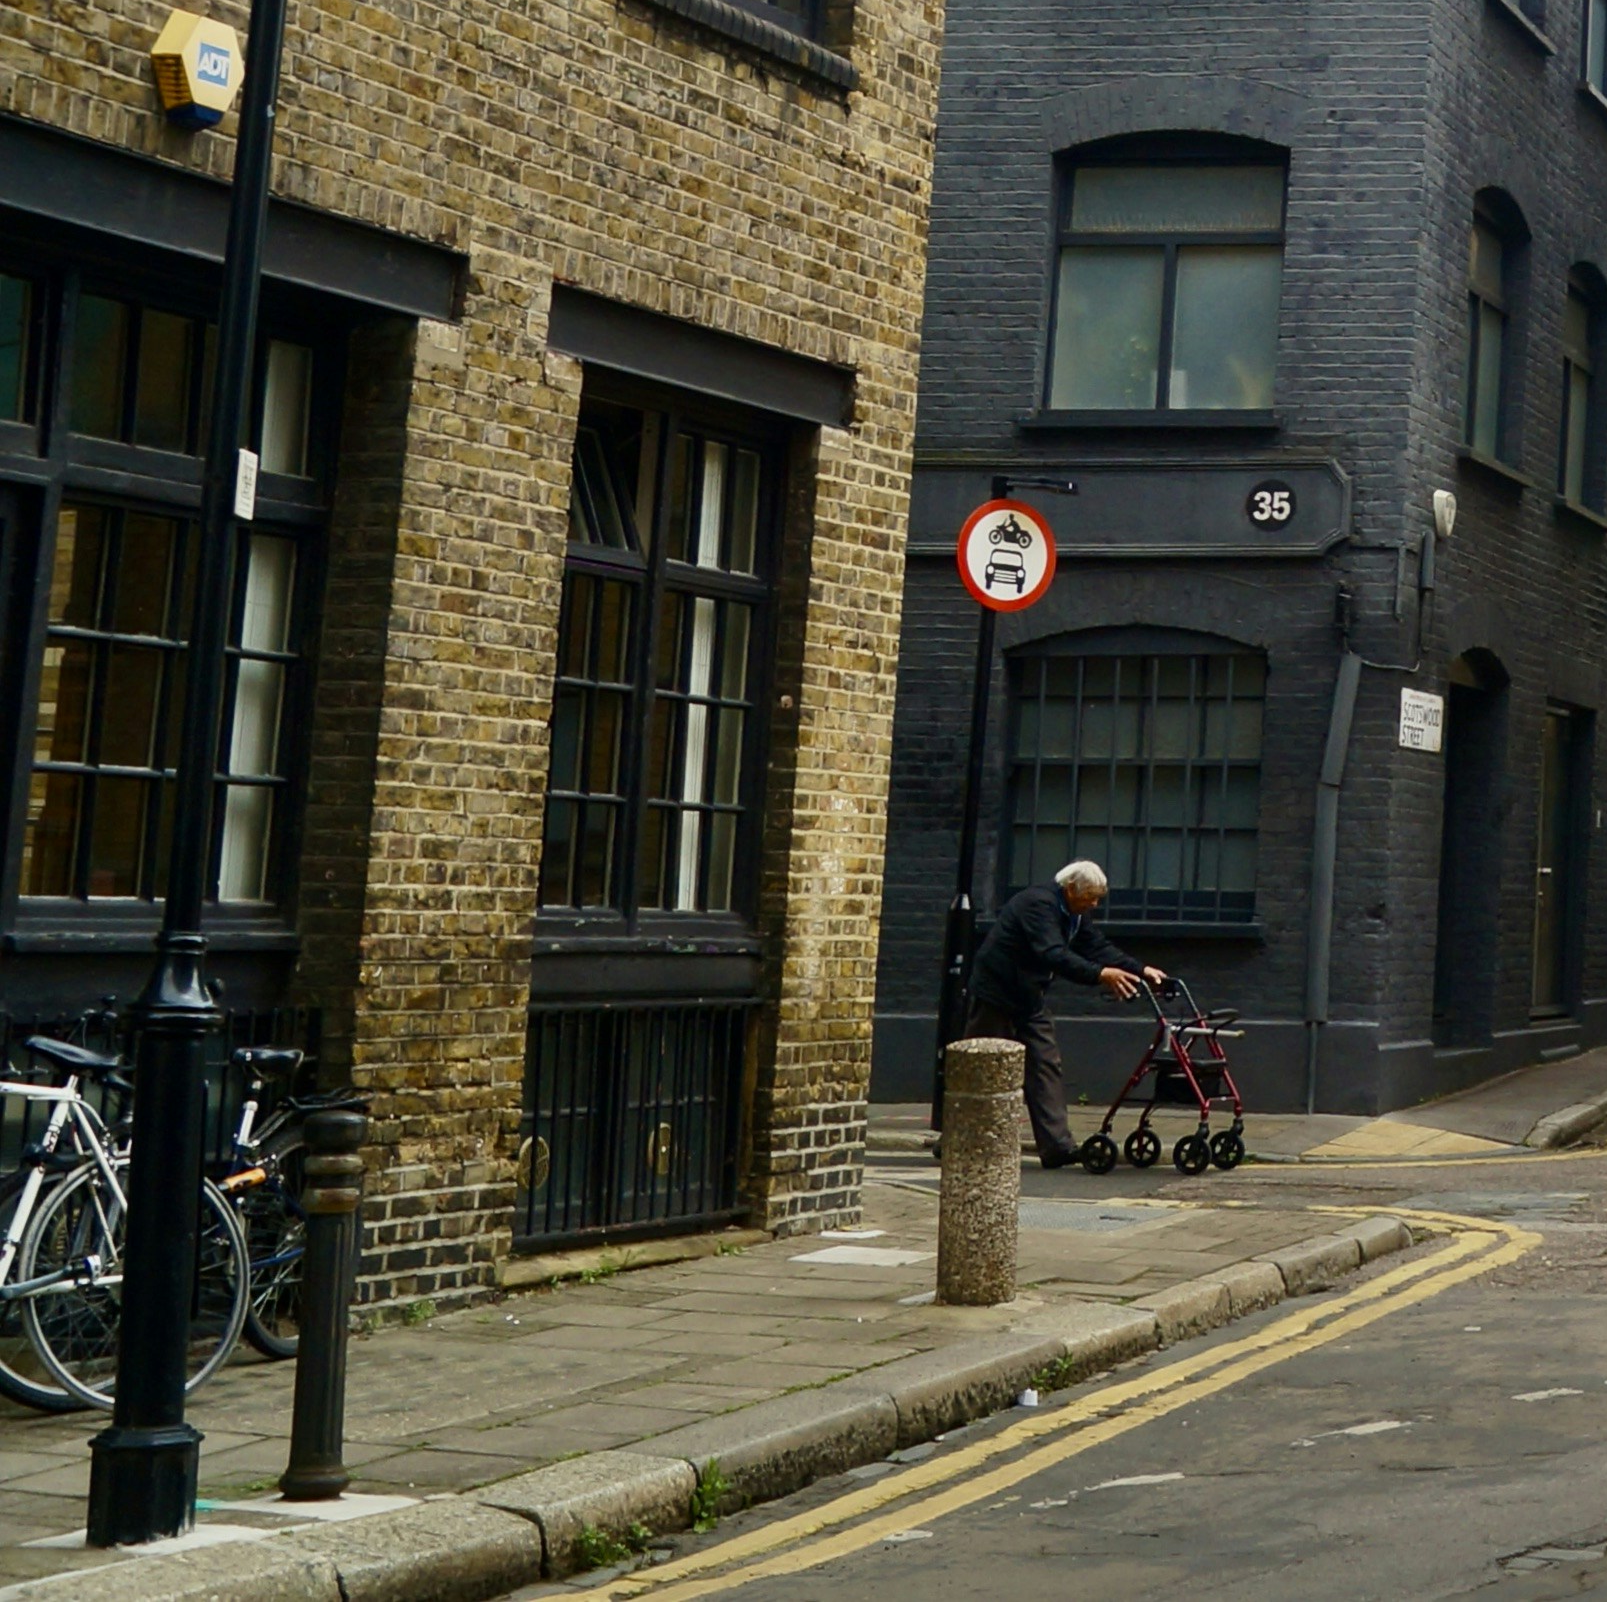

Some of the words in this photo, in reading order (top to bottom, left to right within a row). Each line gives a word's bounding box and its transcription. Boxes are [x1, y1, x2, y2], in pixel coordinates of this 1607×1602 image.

[198, 50, 230, 80] ADT
[1253, 491, 1290, 520] 35
[1403, 701, 1441, 727] SCOTSWOOD
[1402, 724, 1425, 746] STREET
